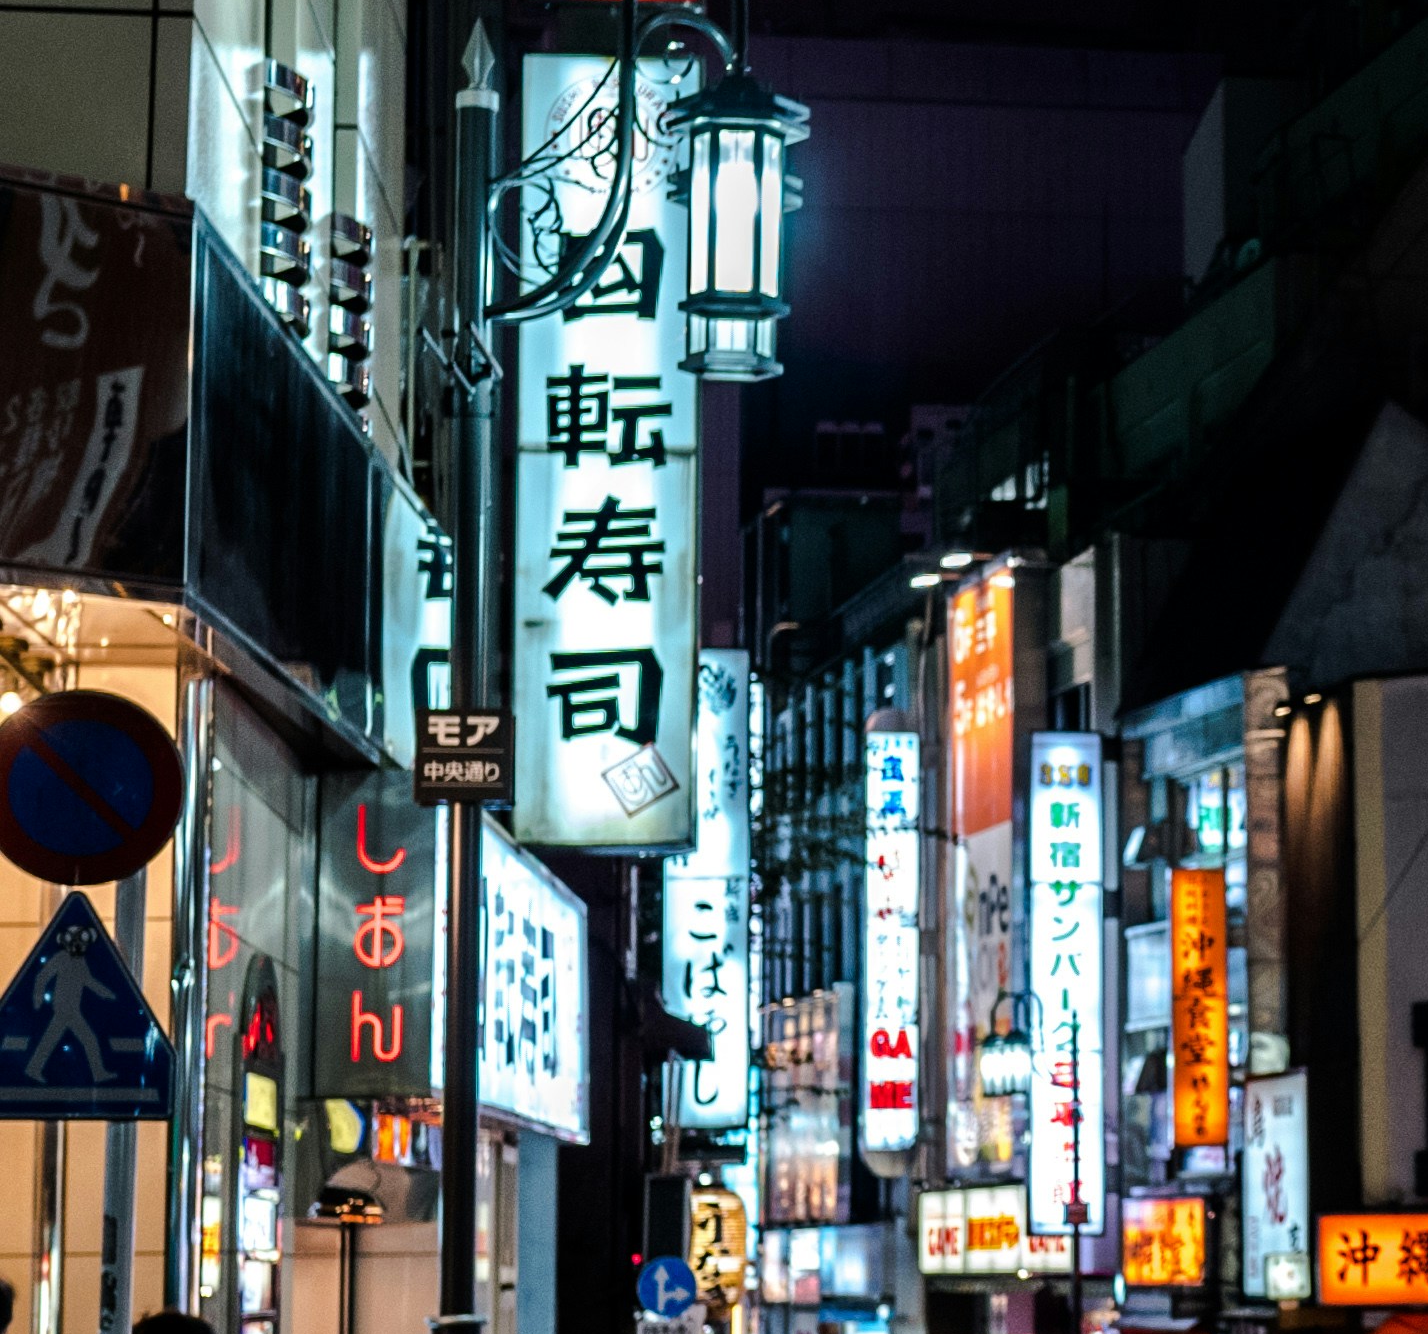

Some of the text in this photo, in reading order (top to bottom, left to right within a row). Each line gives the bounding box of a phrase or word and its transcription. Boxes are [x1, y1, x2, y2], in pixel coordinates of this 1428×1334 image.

[427, 715, 500, 746] モア
[423, 759, 500, 783] 中央通り
